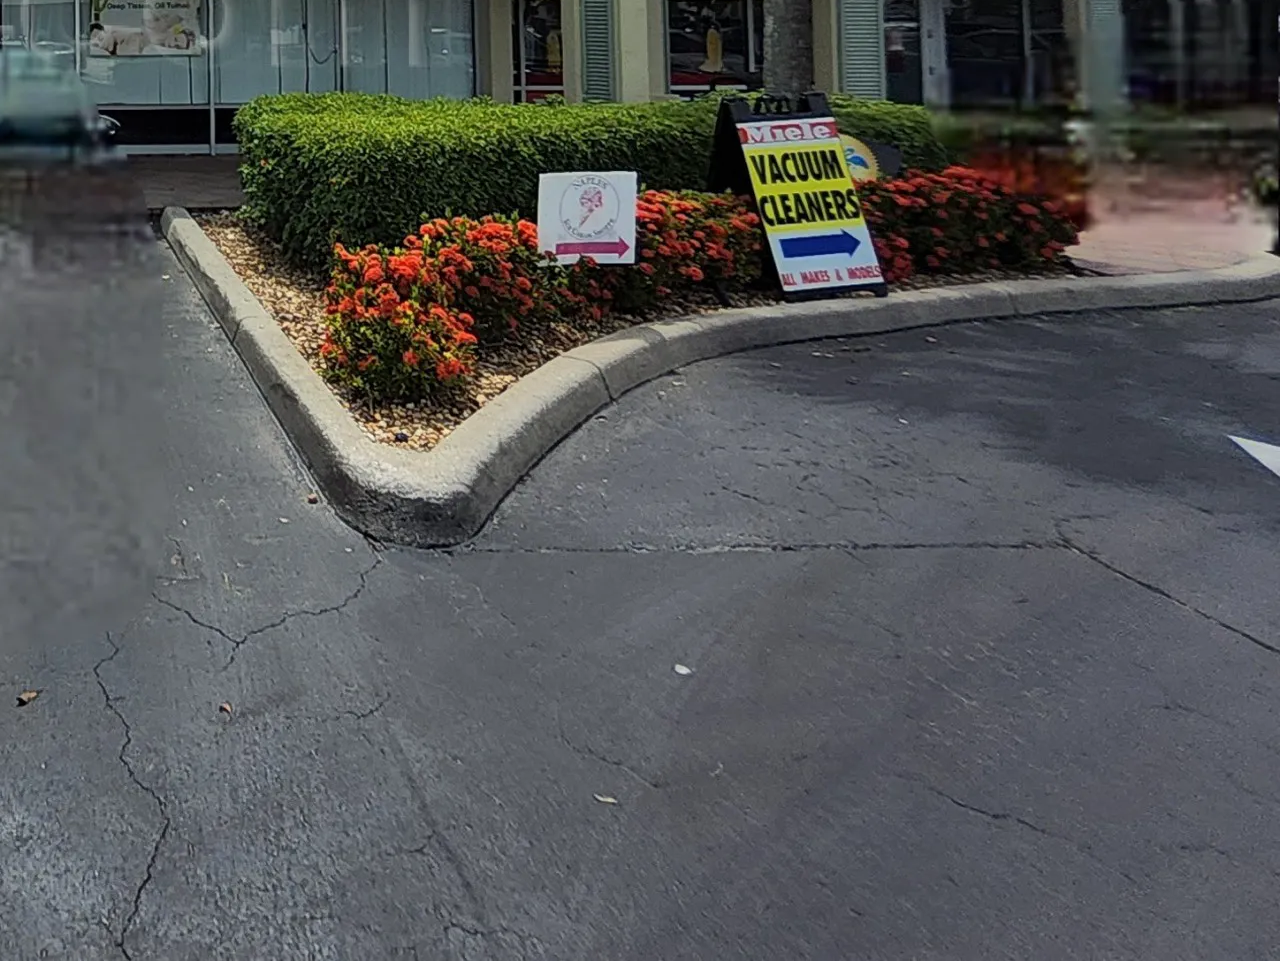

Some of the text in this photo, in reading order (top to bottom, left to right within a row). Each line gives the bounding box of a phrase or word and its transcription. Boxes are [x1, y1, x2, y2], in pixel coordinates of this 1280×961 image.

[746, 123, 833, 143] Miele
[749, 149, 845, 185] VACUUM
[572, 176, 609, 190] NAPLES
[759, 188, 861, 227] CLEANERS
[781, 273, 797, 287] ALL
[801, 269, 830, 285] MAKES
[847, 265, 881, 281] MODELS
